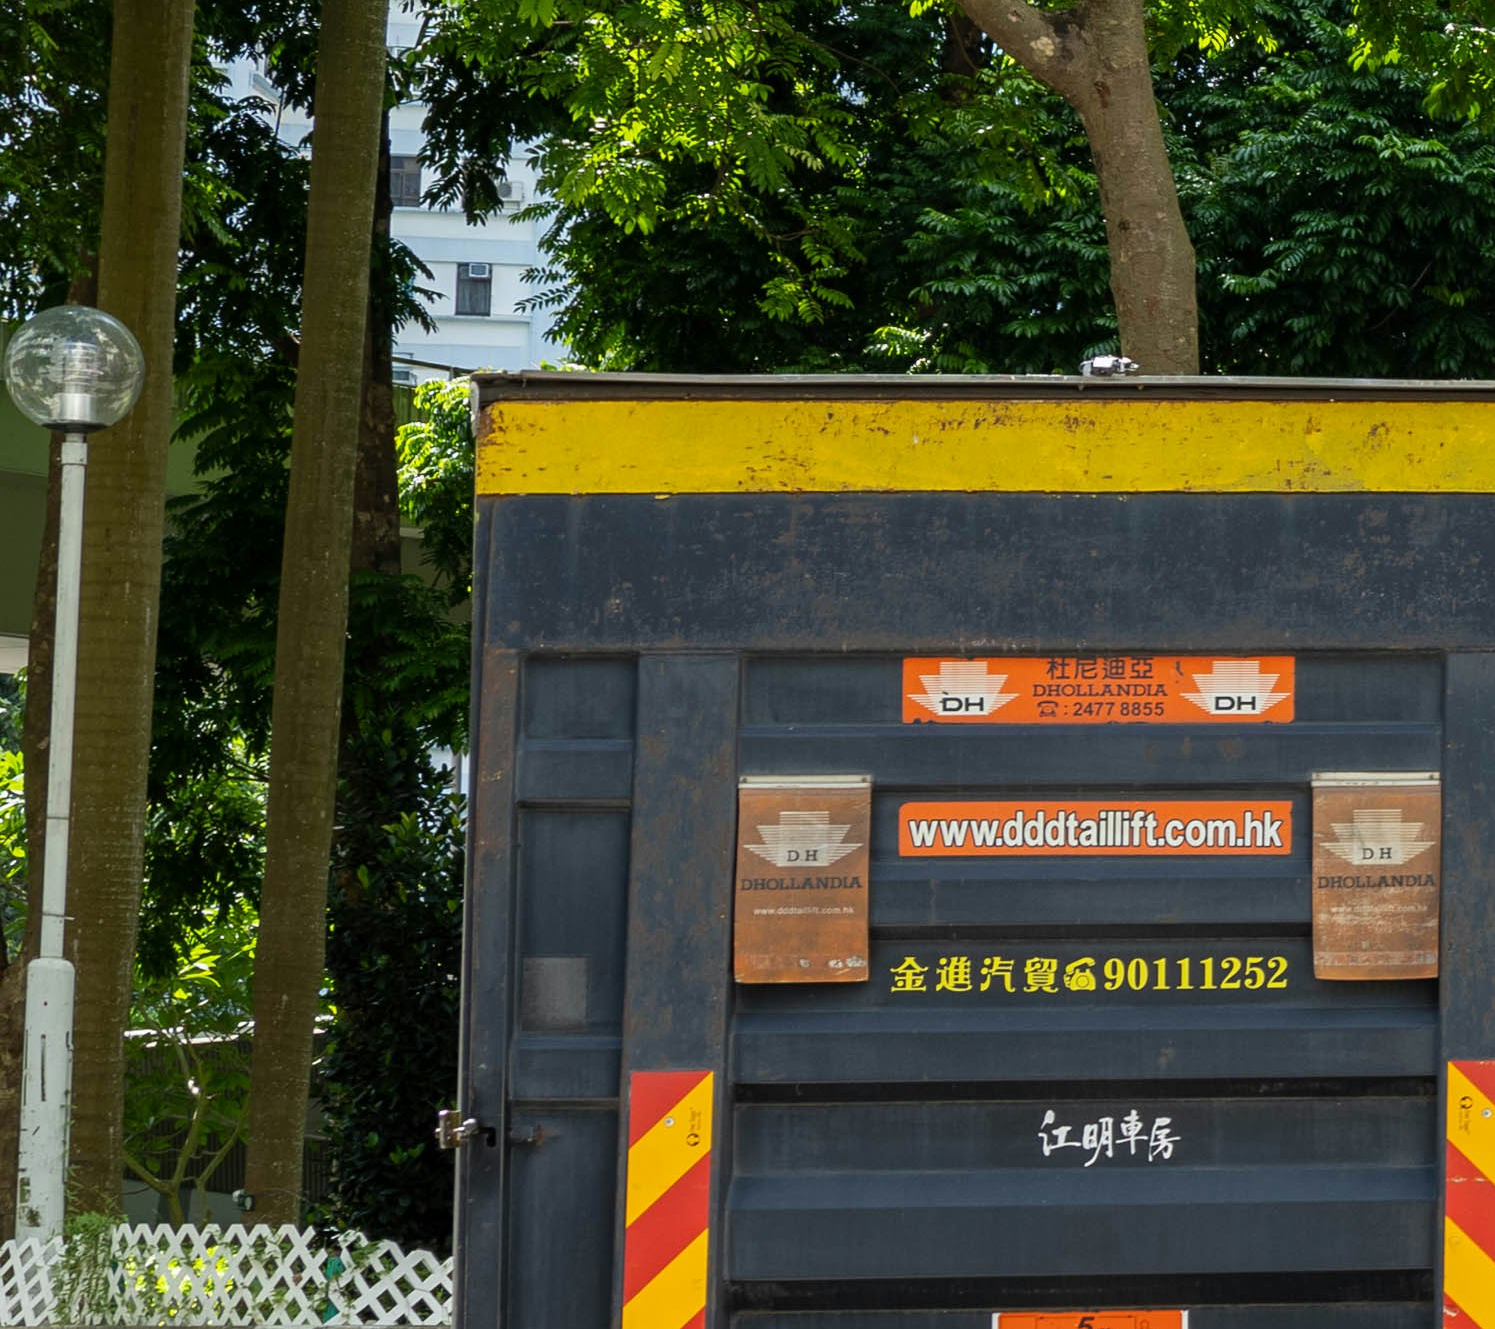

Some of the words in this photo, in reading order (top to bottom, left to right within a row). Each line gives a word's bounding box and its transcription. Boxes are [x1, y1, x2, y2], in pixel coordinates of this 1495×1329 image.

[1046, 656, 1156, 680] 杜尼迪亞
[1033, 683, 1168, 697] DHOLLANDIA
[941, 696, 985, 712] DH
[1073, 701, 1115, 717] 2477
[1119, 701, 1165, 717] 8855
[1213, 695, 1257, 711] DH
[907, 811, 1283, 849] www.dddtaillift.com.hk
[740, 875, 863, 891] DHOLLANDIA
[1317, 873, 1436, 890] DHOLLANDIA
[889, 955, 1059, 993] 金進汽貿
[1102, 956, 1289, 991] 90111252
[1037, 1109, 1182, 1168] 江明車房
